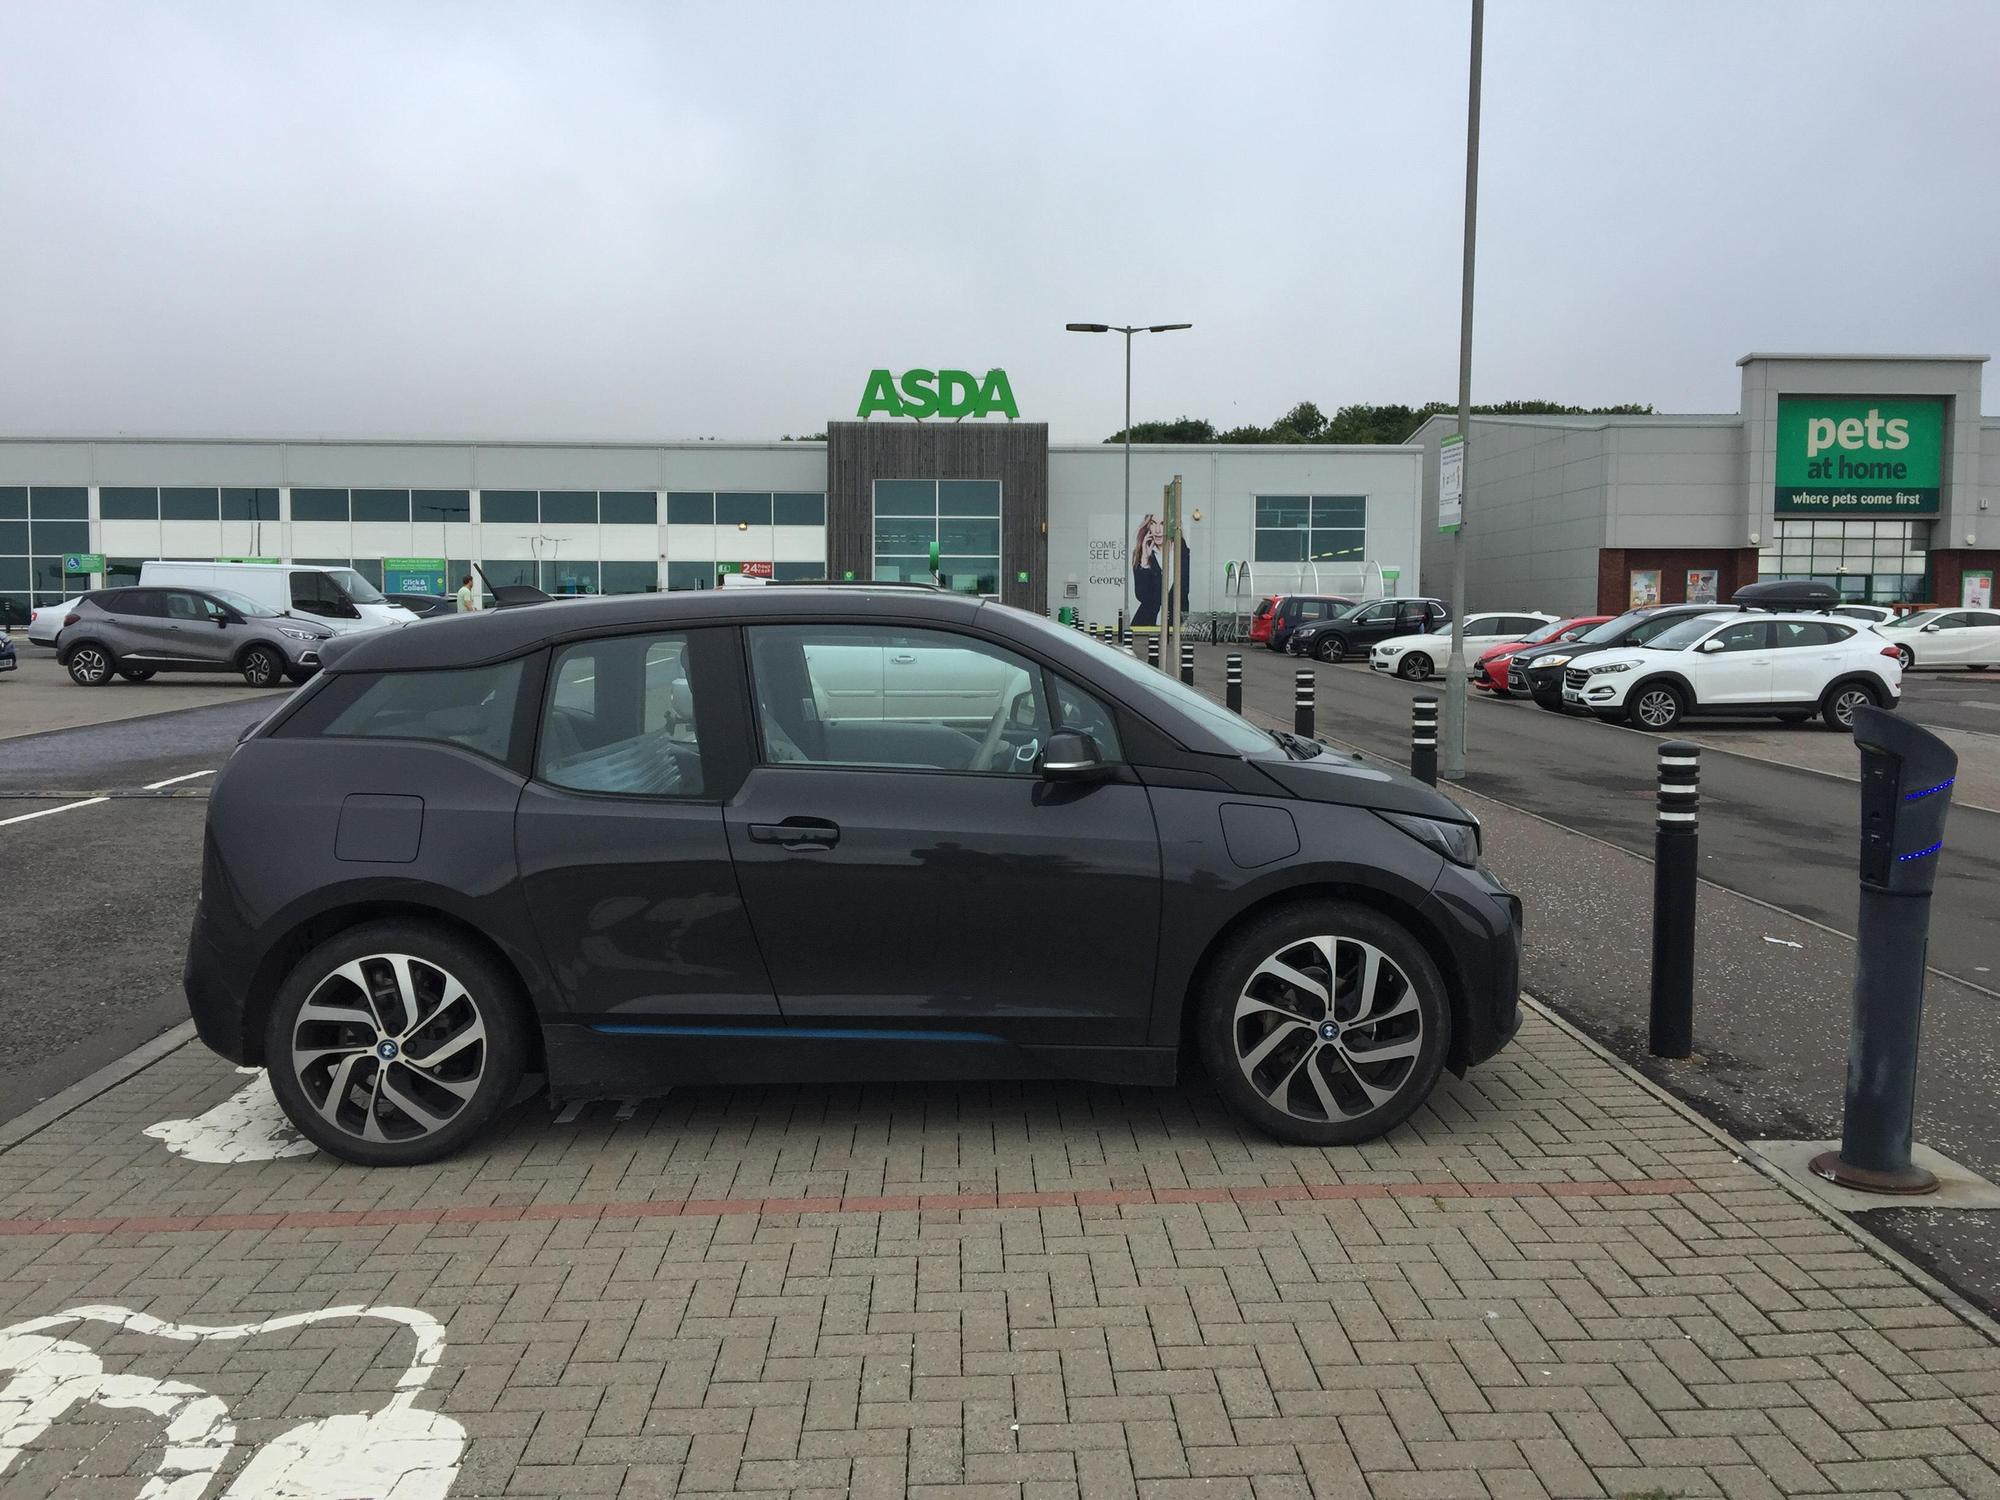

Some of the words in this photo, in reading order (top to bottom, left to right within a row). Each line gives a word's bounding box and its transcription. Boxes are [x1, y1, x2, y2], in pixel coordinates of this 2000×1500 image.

[856, 368, 1020, 418] ASDA
[1807, 408, 1910, 458] pets
[1807, 457, 1833, 480] at
[1838, 455, 1907, 480] home
[1792, 492, 1829, 505] where
[1832, 493, 1858, 507] pets
[1860, 493, 1893, 505] come
[1895, 492, 1920, 505] first
[1089, 540, 1117, 549] COME
[1089, 549, 1110, 560] SEE
[742, 563, 758, 574] 24
[1089, 576, 1126, 587] George
